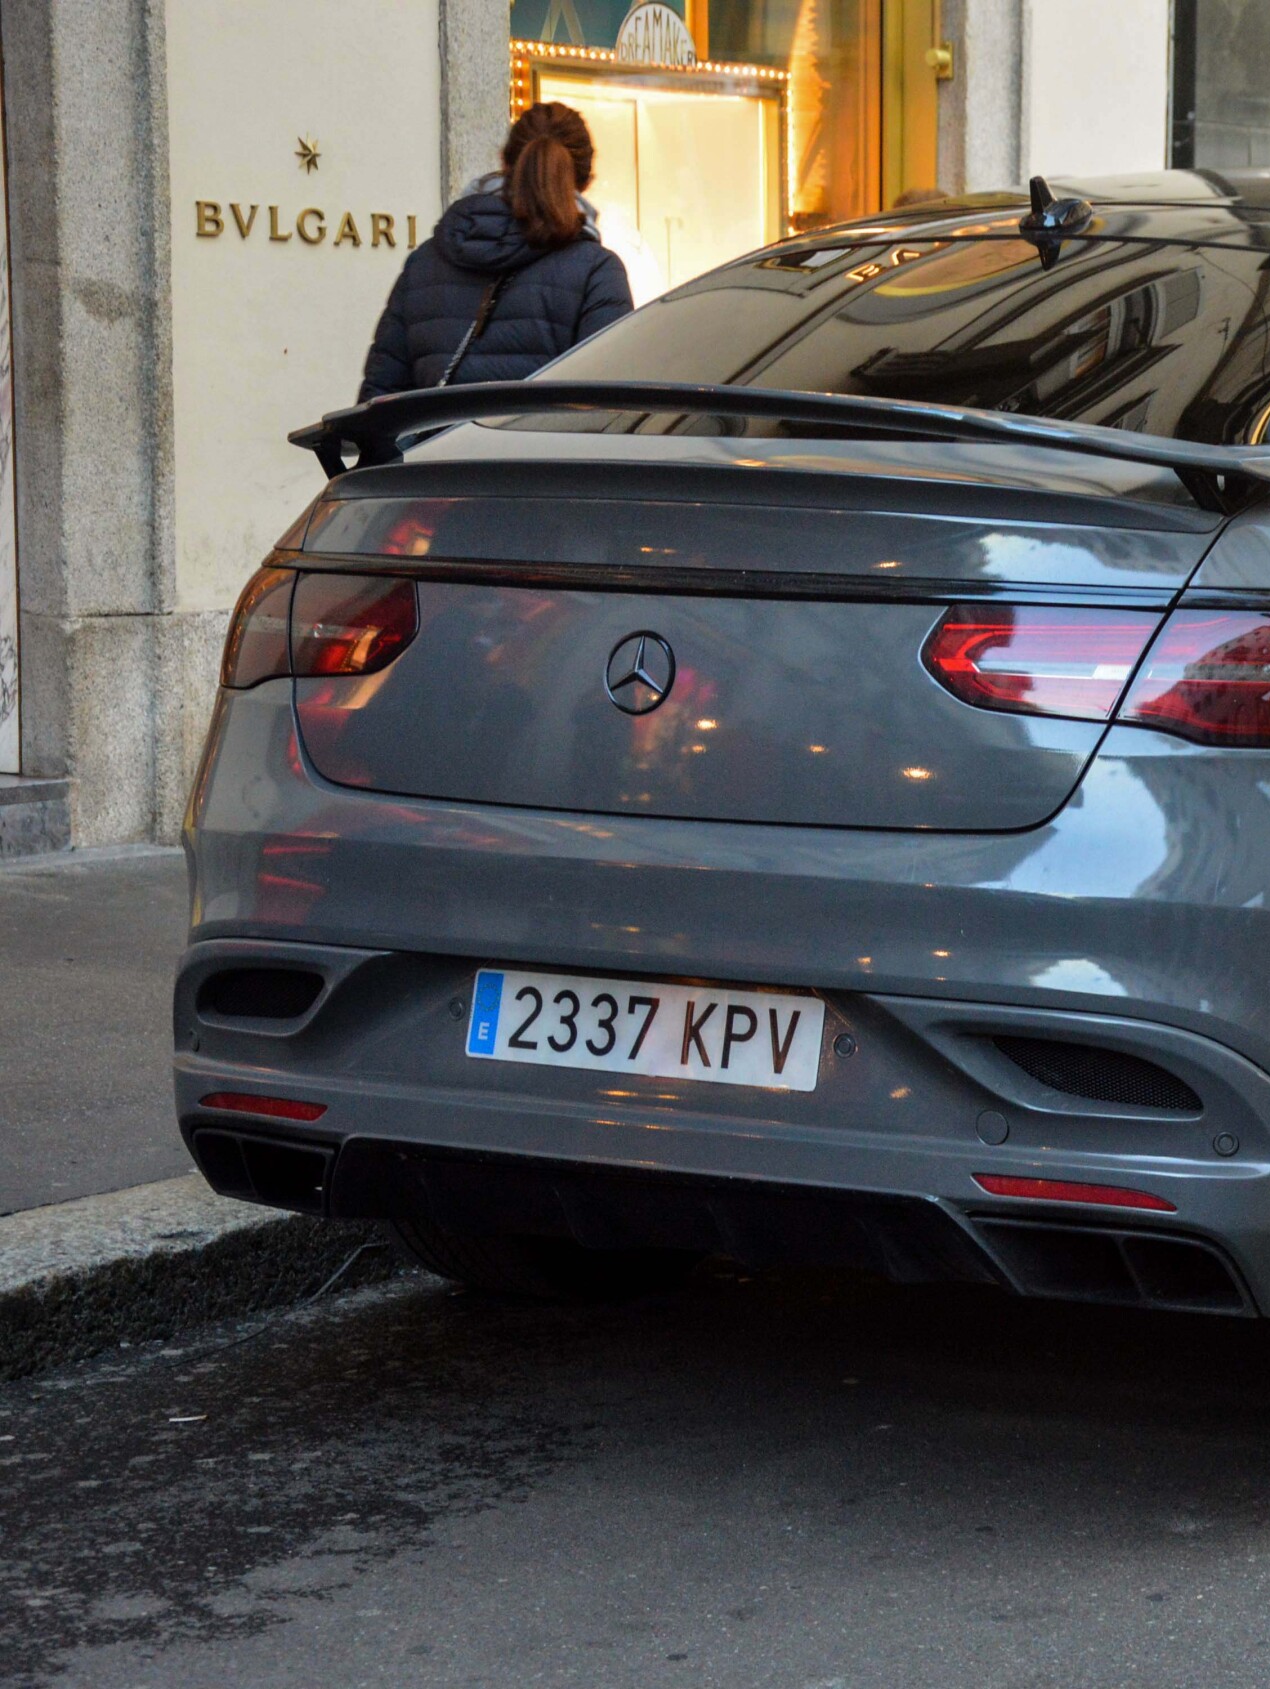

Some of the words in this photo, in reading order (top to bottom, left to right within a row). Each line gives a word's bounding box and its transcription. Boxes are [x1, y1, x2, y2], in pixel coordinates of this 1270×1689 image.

[195, 200, 418, 250] BVLGARI
[477, 1021, 490, 1041] E
[508, 985, 661, 1061] 2337
[679, 1000, 802, 1075] KPV
